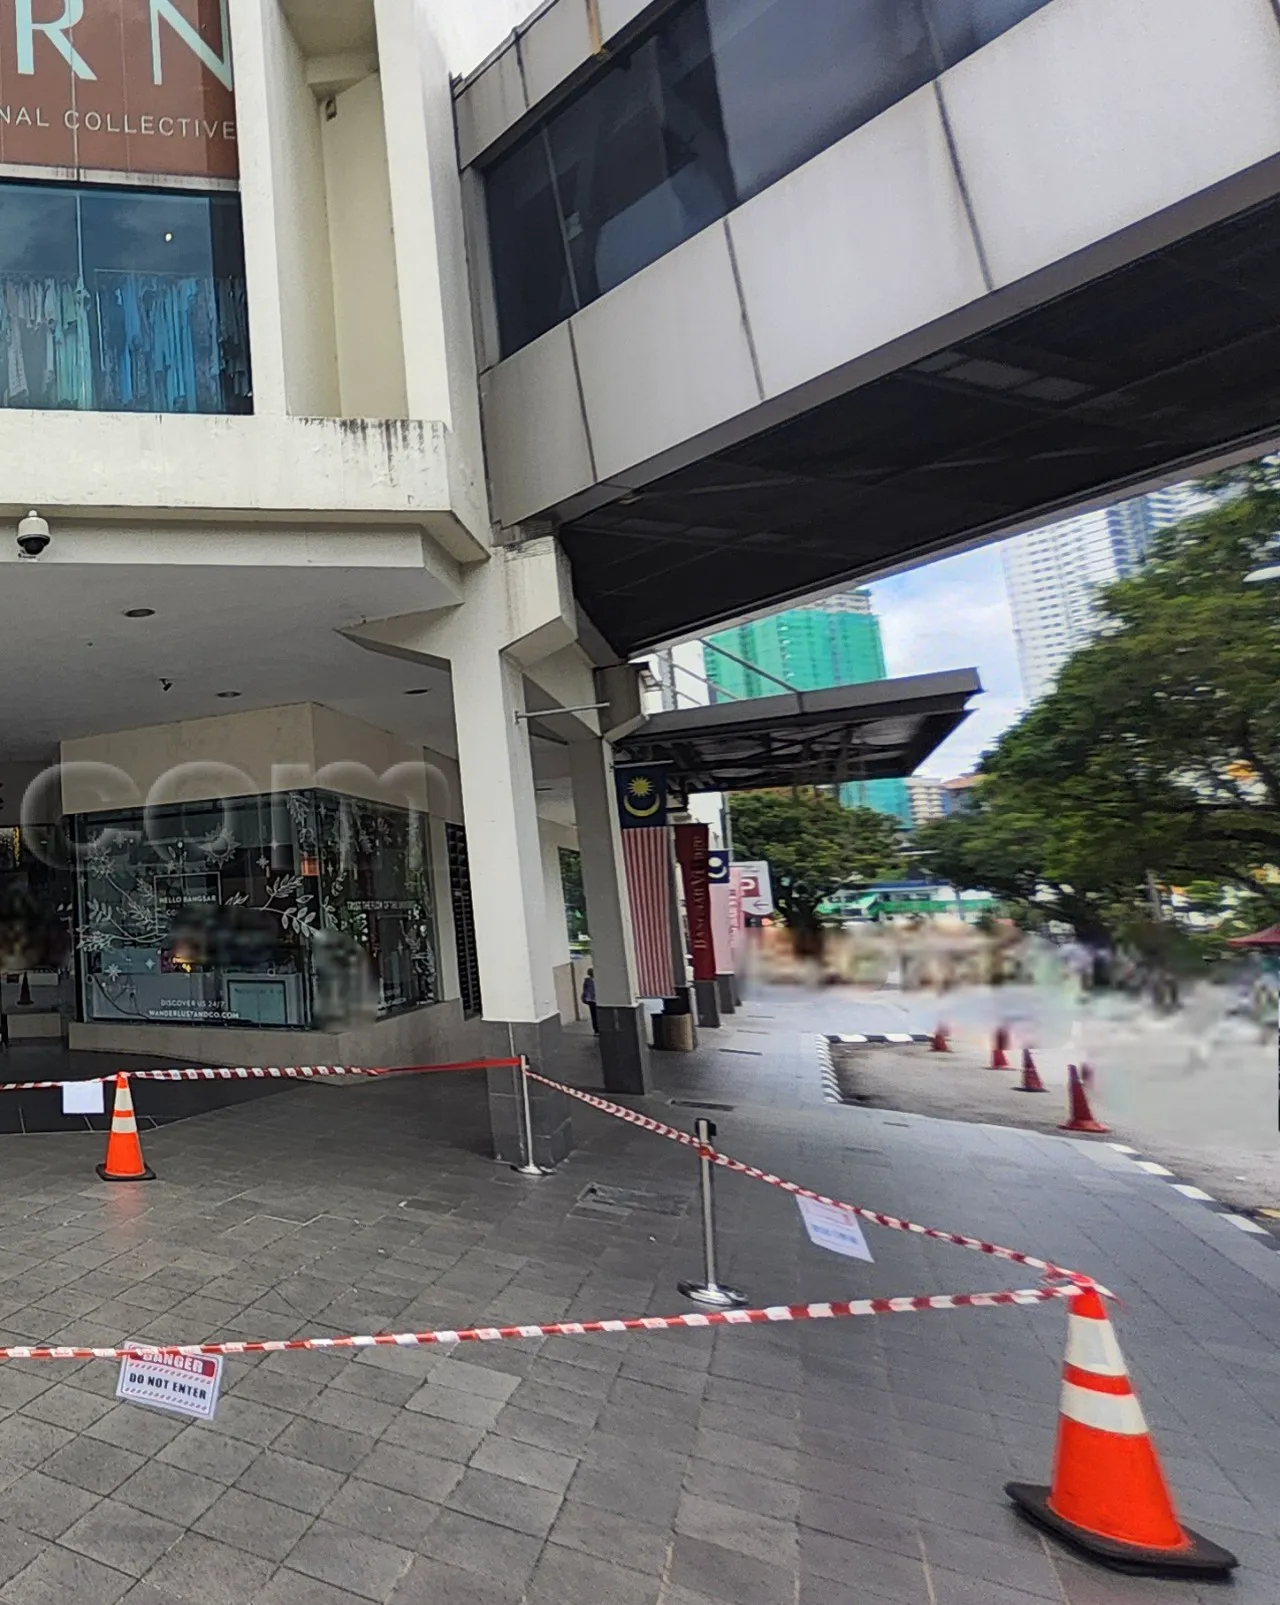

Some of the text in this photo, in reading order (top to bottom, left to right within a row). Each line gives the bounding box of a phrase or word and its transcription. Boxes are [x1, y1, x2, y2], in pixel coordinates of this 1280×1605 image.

[64, 109, 237, 141] COLLECTIVE
[160, 999, 195, 1007] DISCOVER
[149, 1010, 239, 1019] WANDERLUSTANDCO.COM
[129, 1372, 207, 1400] DO NOT ENTER
